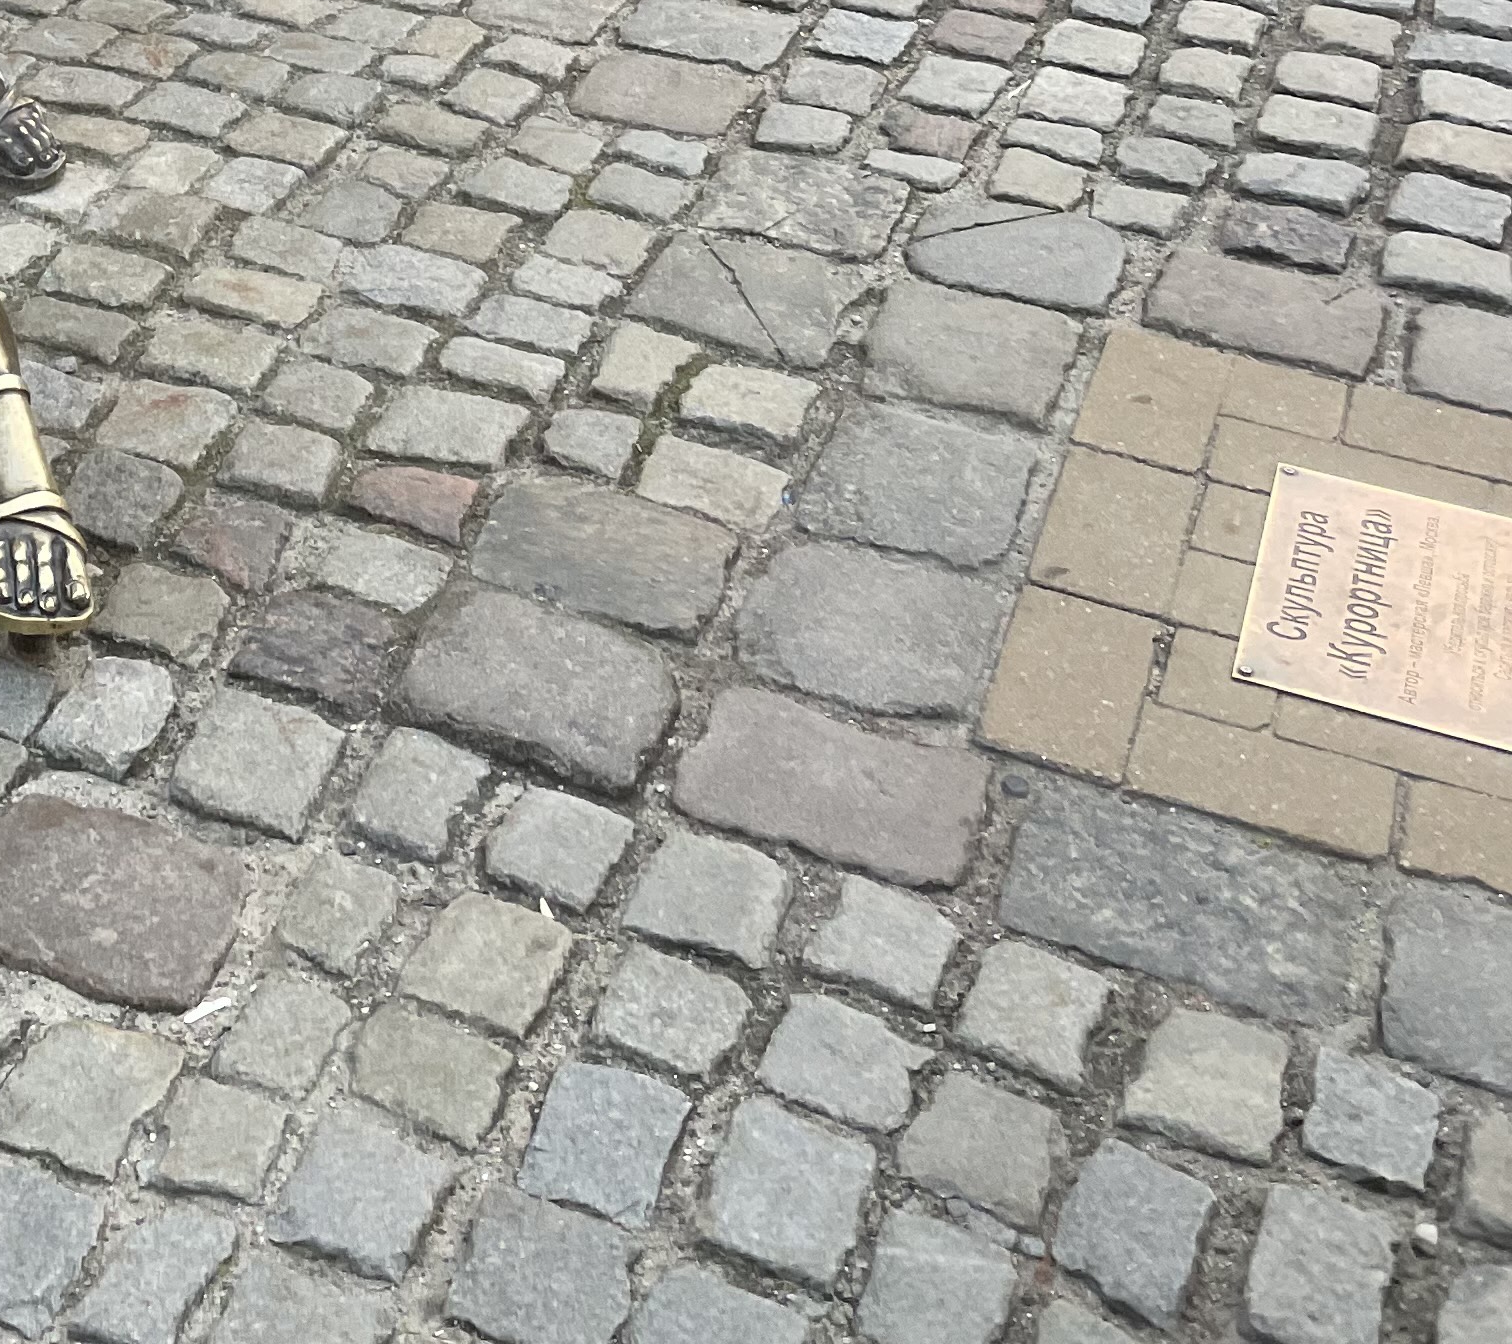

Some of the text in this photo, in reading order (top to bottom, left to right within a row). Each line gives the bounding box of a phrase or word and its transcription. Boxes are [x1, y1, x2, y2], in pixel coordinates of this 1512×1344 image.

[1266, 510, 1336, 641] Скульптура
[1326, 509, 1399, 679] «Курортница»
[1398, 668, 1424, 706] Автор
